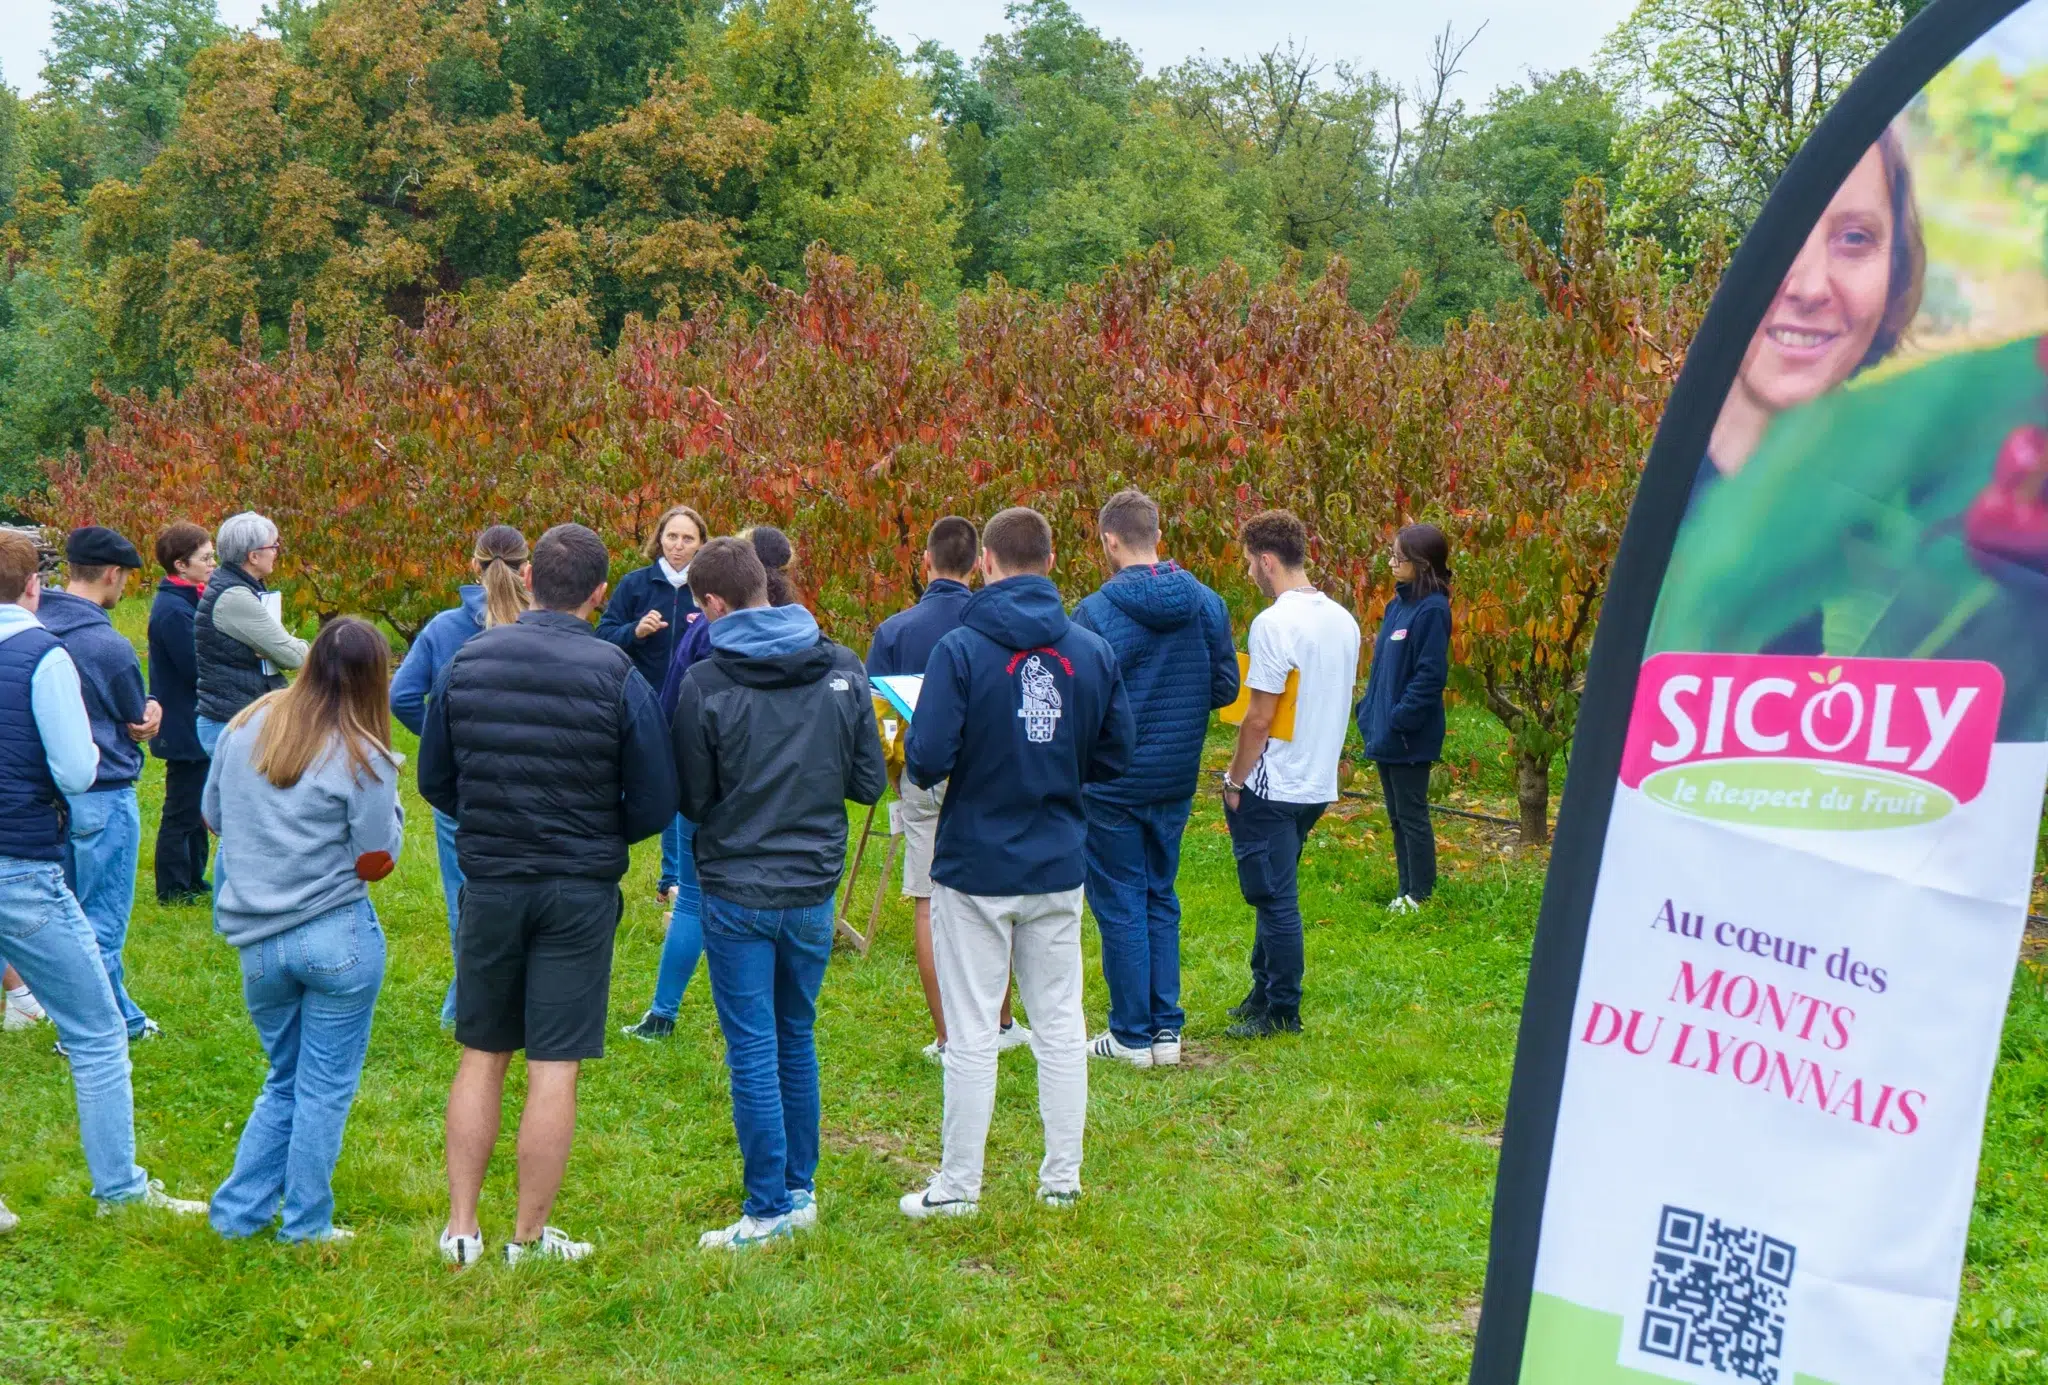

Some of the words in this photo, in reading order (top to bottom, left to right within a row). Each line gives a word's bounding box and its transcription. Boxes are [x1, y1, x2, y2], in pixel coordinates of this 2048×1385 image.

[1650, 673, 1979, 772] SICOLY
[1672, 777, 1697, 802] le
[1704, 780, 1813, 811] Respect
[1819, 787, 1855, 812] du
[1860, 788, 1927, 815] Fruit
[1650, 898, 1704, 940] Au
[1714, 921, 1817, 970] cœur
[1825, 946, 1888, 994] des
[1668, 960, 1856, 1051] MONTS
[1581, 1001, 1664, 1055] DU
[1668, 1022, 1927, 1135] LYONNAIS
